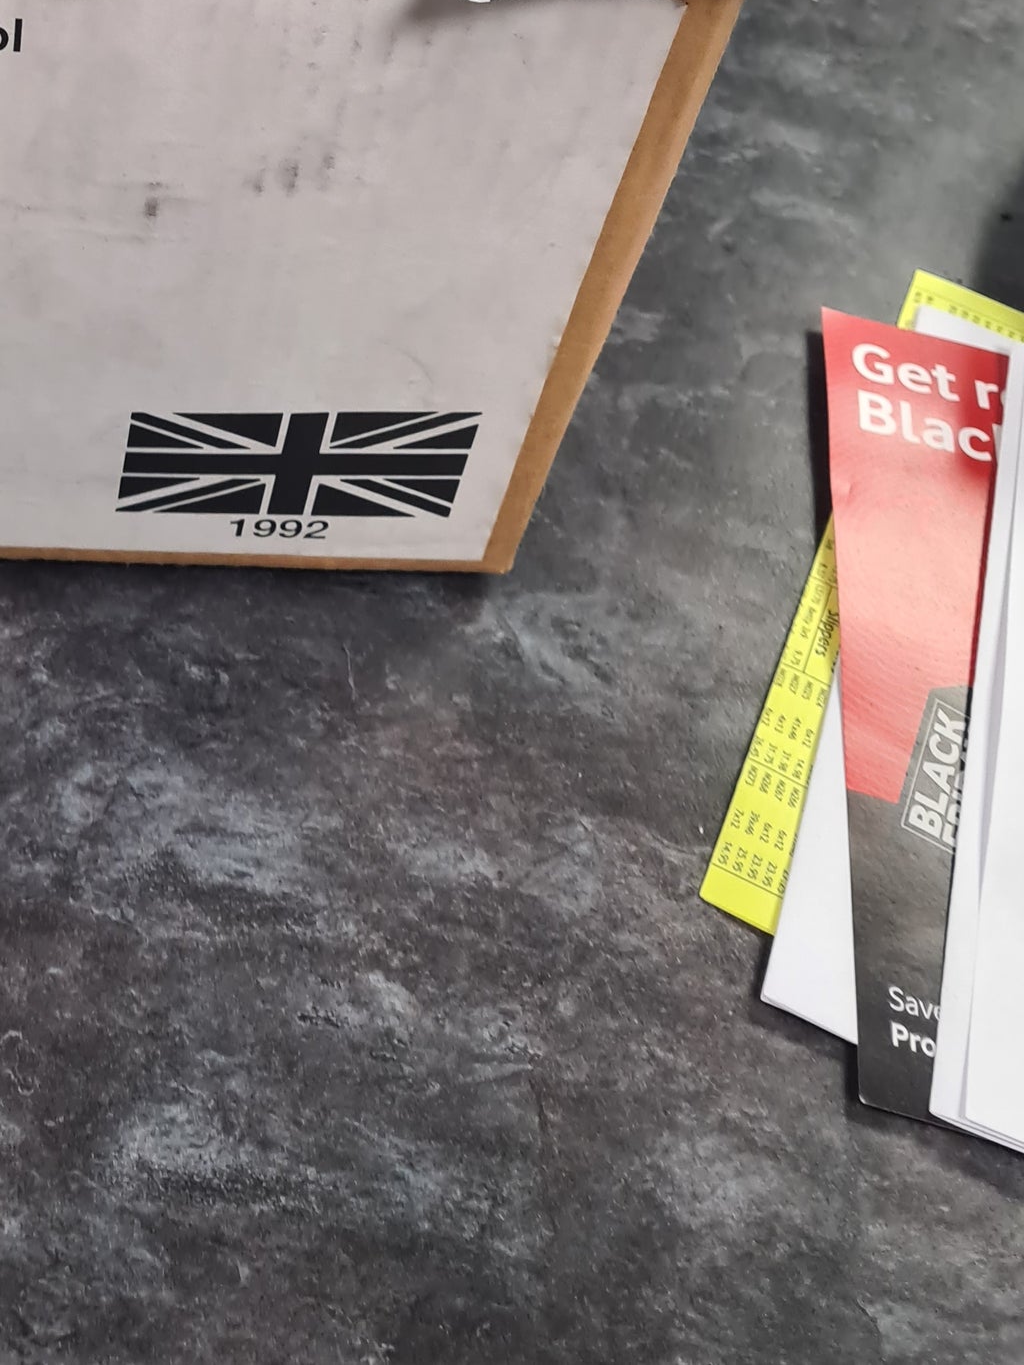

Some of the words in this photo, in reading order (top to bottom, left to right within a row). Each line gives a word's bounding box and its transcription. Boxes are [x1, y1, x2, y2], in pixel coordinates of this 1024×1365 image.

[851, 343, 960, 402] Get
[975, 379, 1006, 410] r
[230, 518, 330, 540] 1992
[815, 609, 840, 659] Slippers
[908, 708, 967, 839] BLACK
[890, 1020, 936, 1058] Pro
